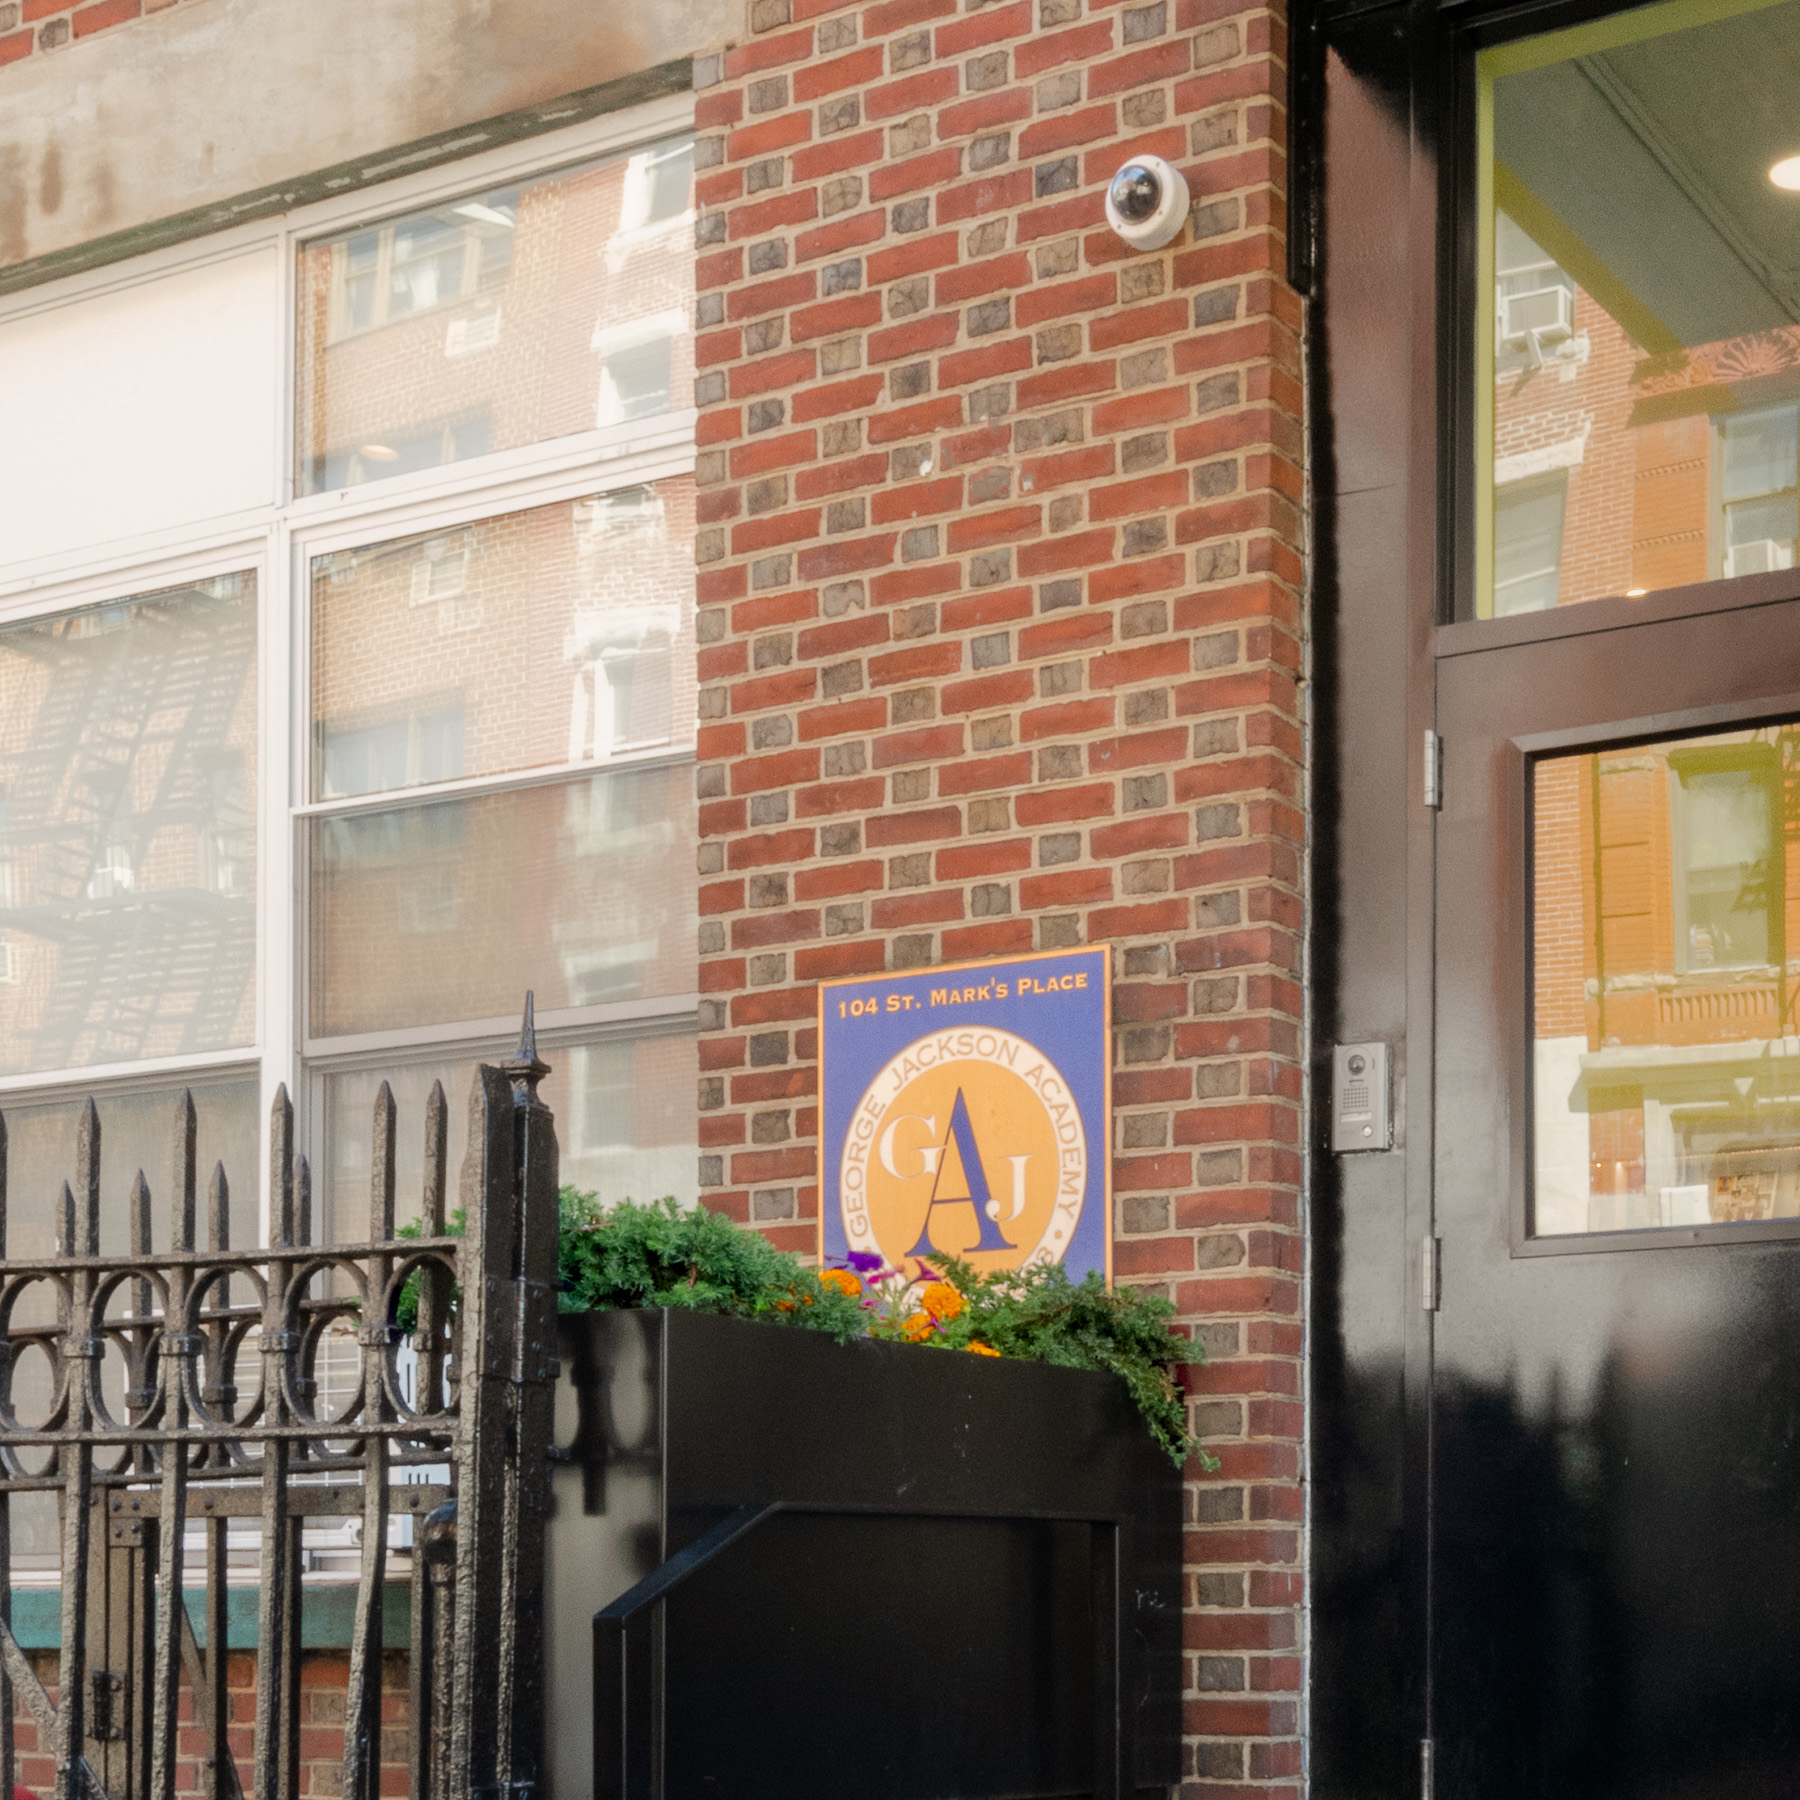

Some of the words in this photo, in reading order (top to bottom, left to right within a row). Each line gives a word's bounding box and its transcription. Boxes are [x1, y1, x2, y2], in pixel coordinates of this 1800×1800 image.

[838, 996, 879, 1019] 104
[845, 1095, 885, 1237] GEORGE
[890, 1033, 1020, 1091] JACKSON
[1025, 1064, 1082, 1220] ACADEMY
